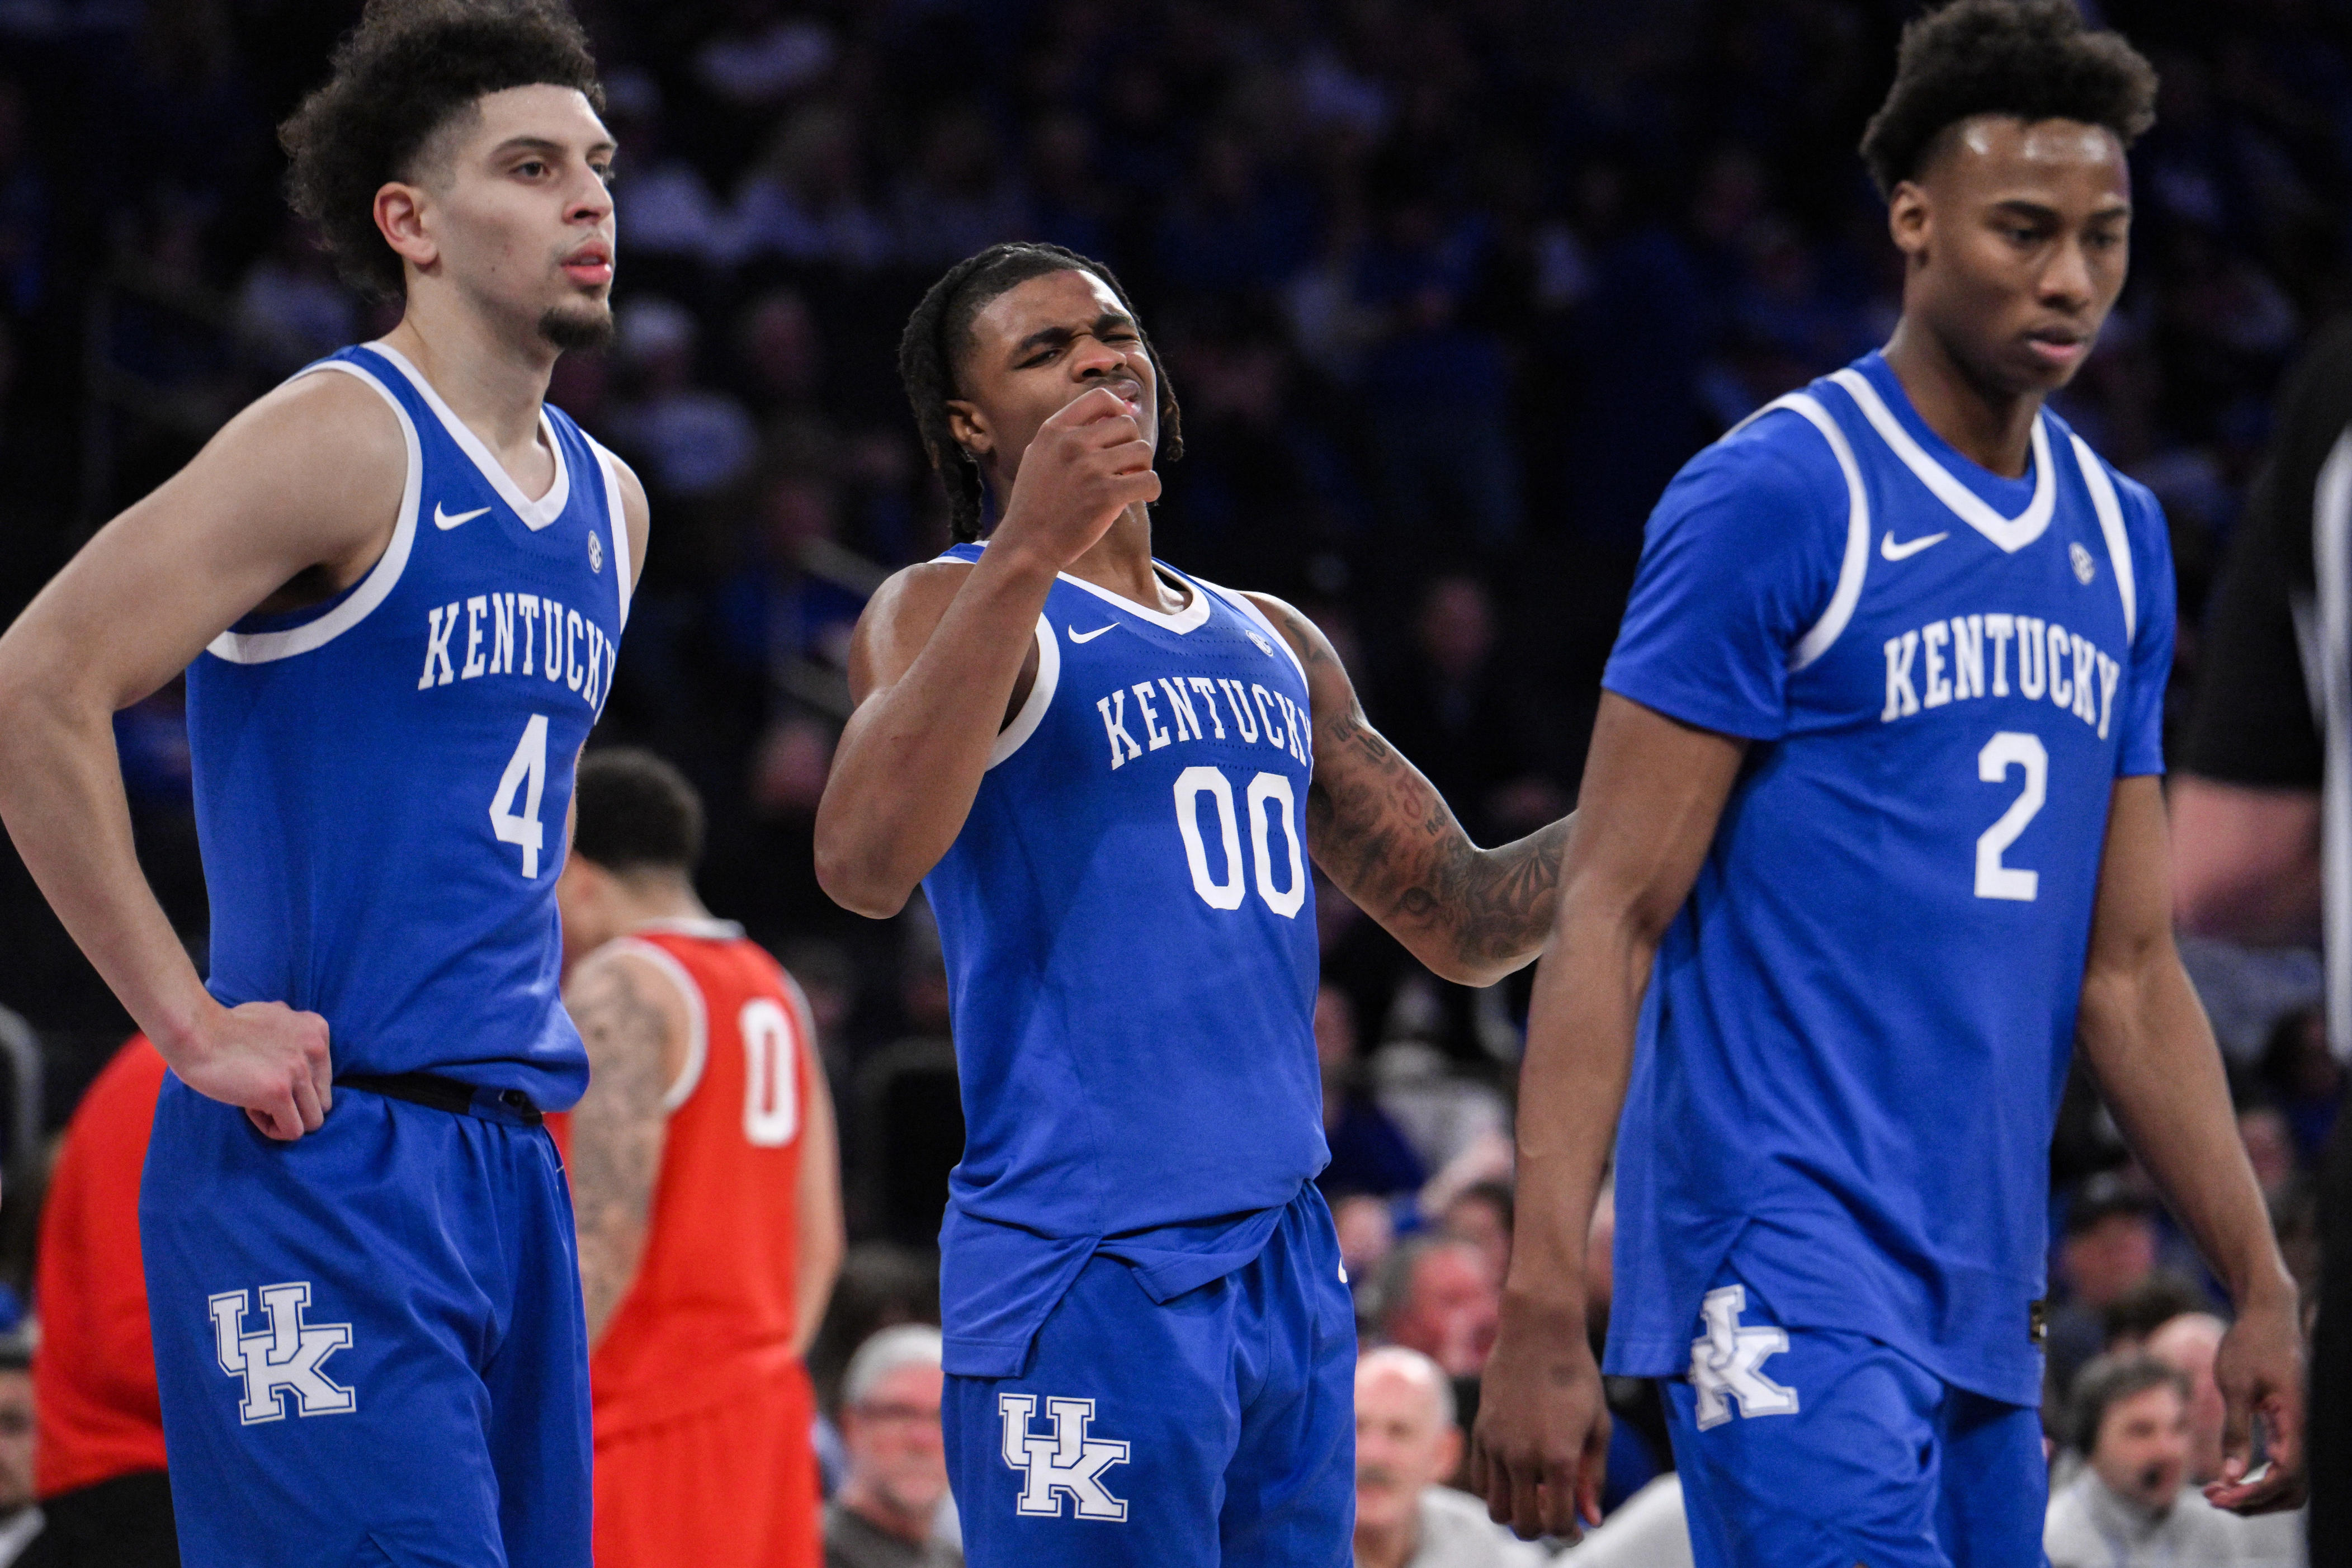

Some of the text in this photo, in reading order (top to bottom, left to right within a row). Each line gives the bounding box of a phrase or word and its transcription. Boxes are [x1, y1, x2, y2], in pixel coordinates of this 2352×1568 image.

[418, 592, 615, 726] KENTUCKY
[1881, 613, 2120, 740] KENTUCKY
[489, 714, 549, 879] 4
[1173, 766, 1306, 919] 00
[1974, 731, 2048, 902] 2
[739, 996, 799, 1147] 0
[208, 1281, 357, 1426] UK
[999, 1392, 1131, 1522] UK
